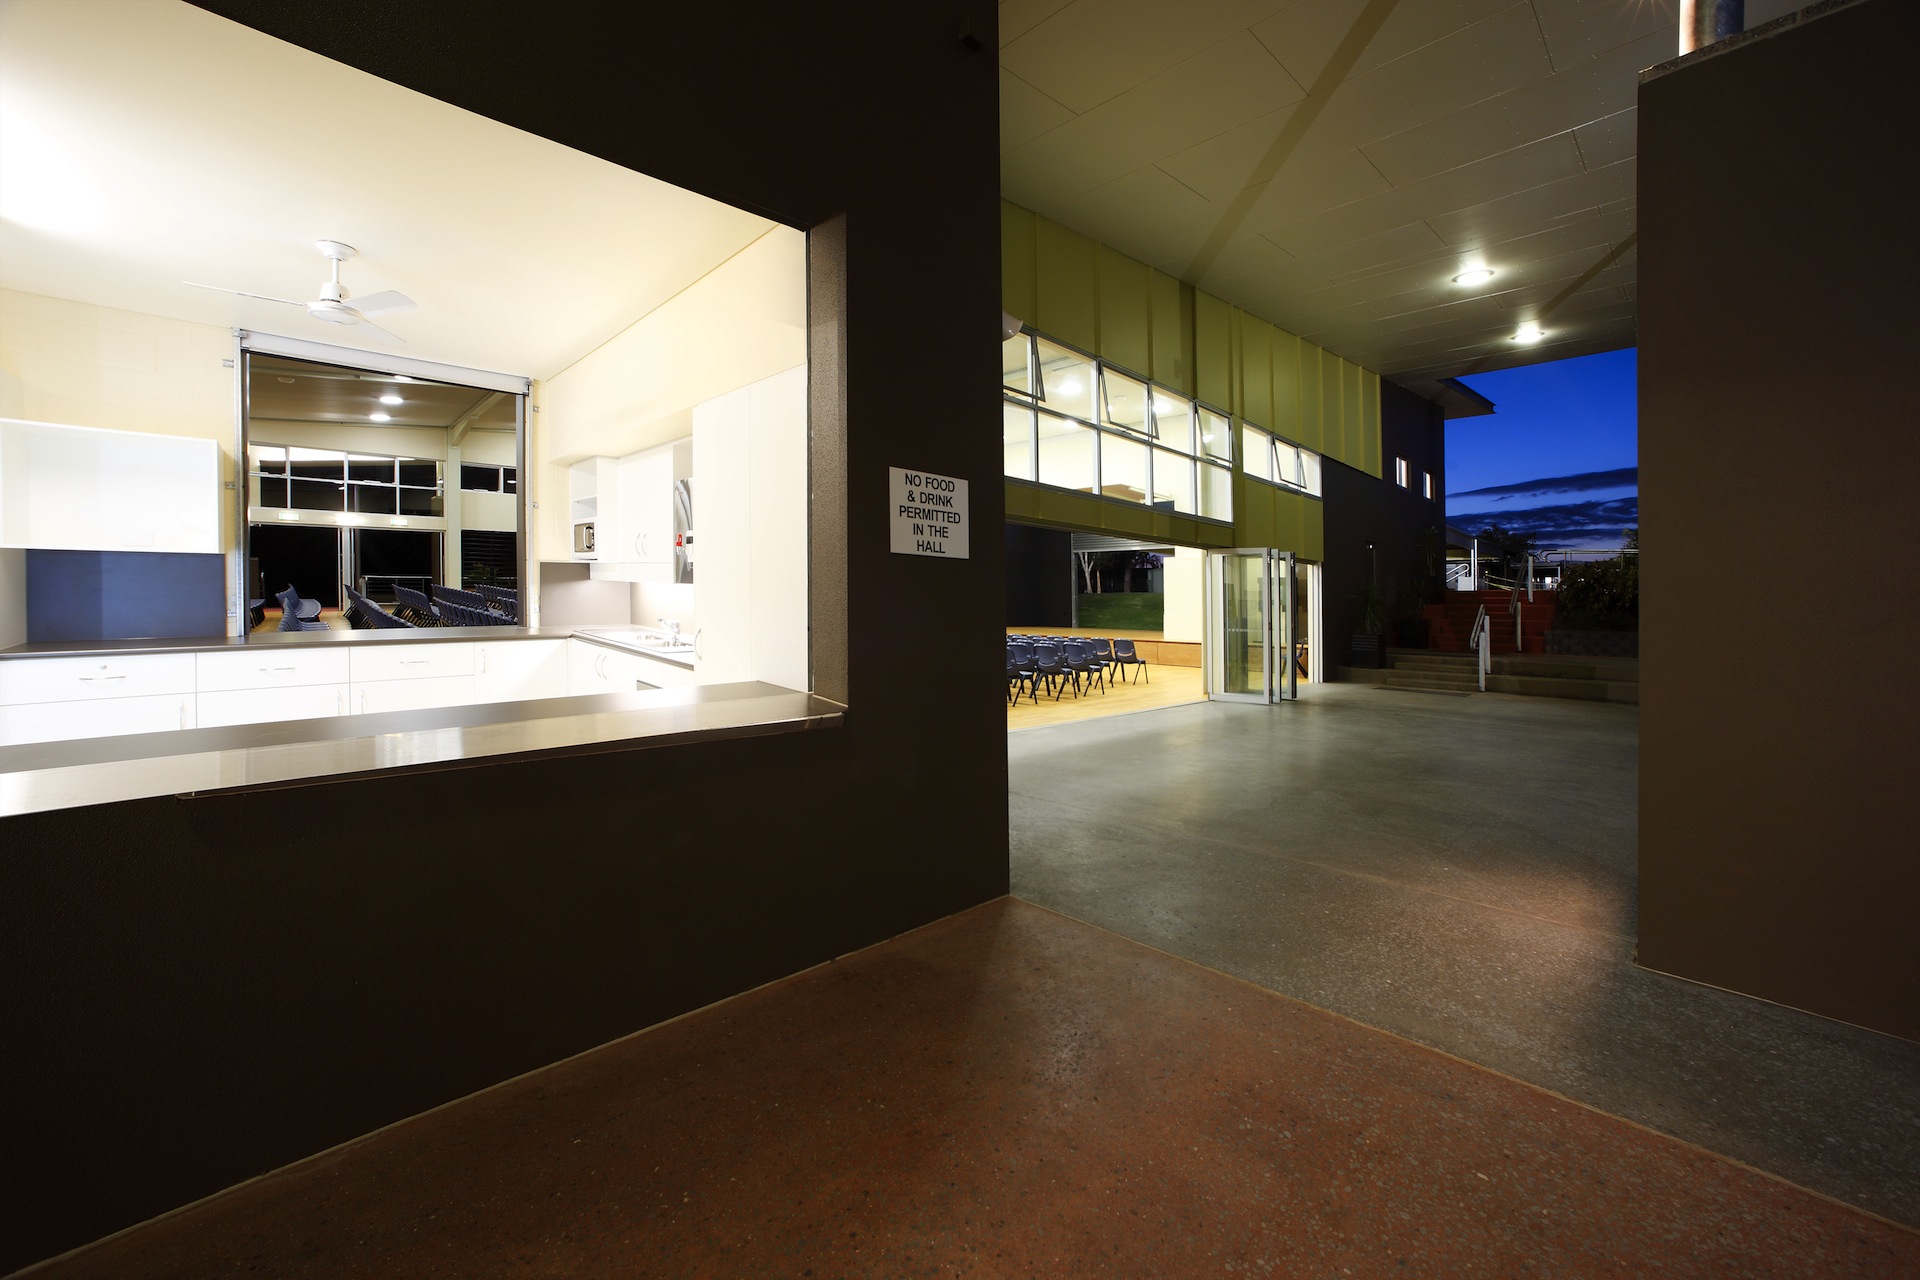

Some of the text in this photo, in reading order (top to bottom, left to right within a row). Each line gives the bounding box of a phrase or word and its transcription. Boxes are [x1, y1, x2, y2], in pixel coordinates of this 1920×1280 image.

[905, 473, 955, 492] NO FOOD
[907, 490, 953, 508] & DRINK
[899, 505, 961, 524] PERMITTED
[913, 523, 949, 538] IN THE
[917, 539, 945, 553] HALL
